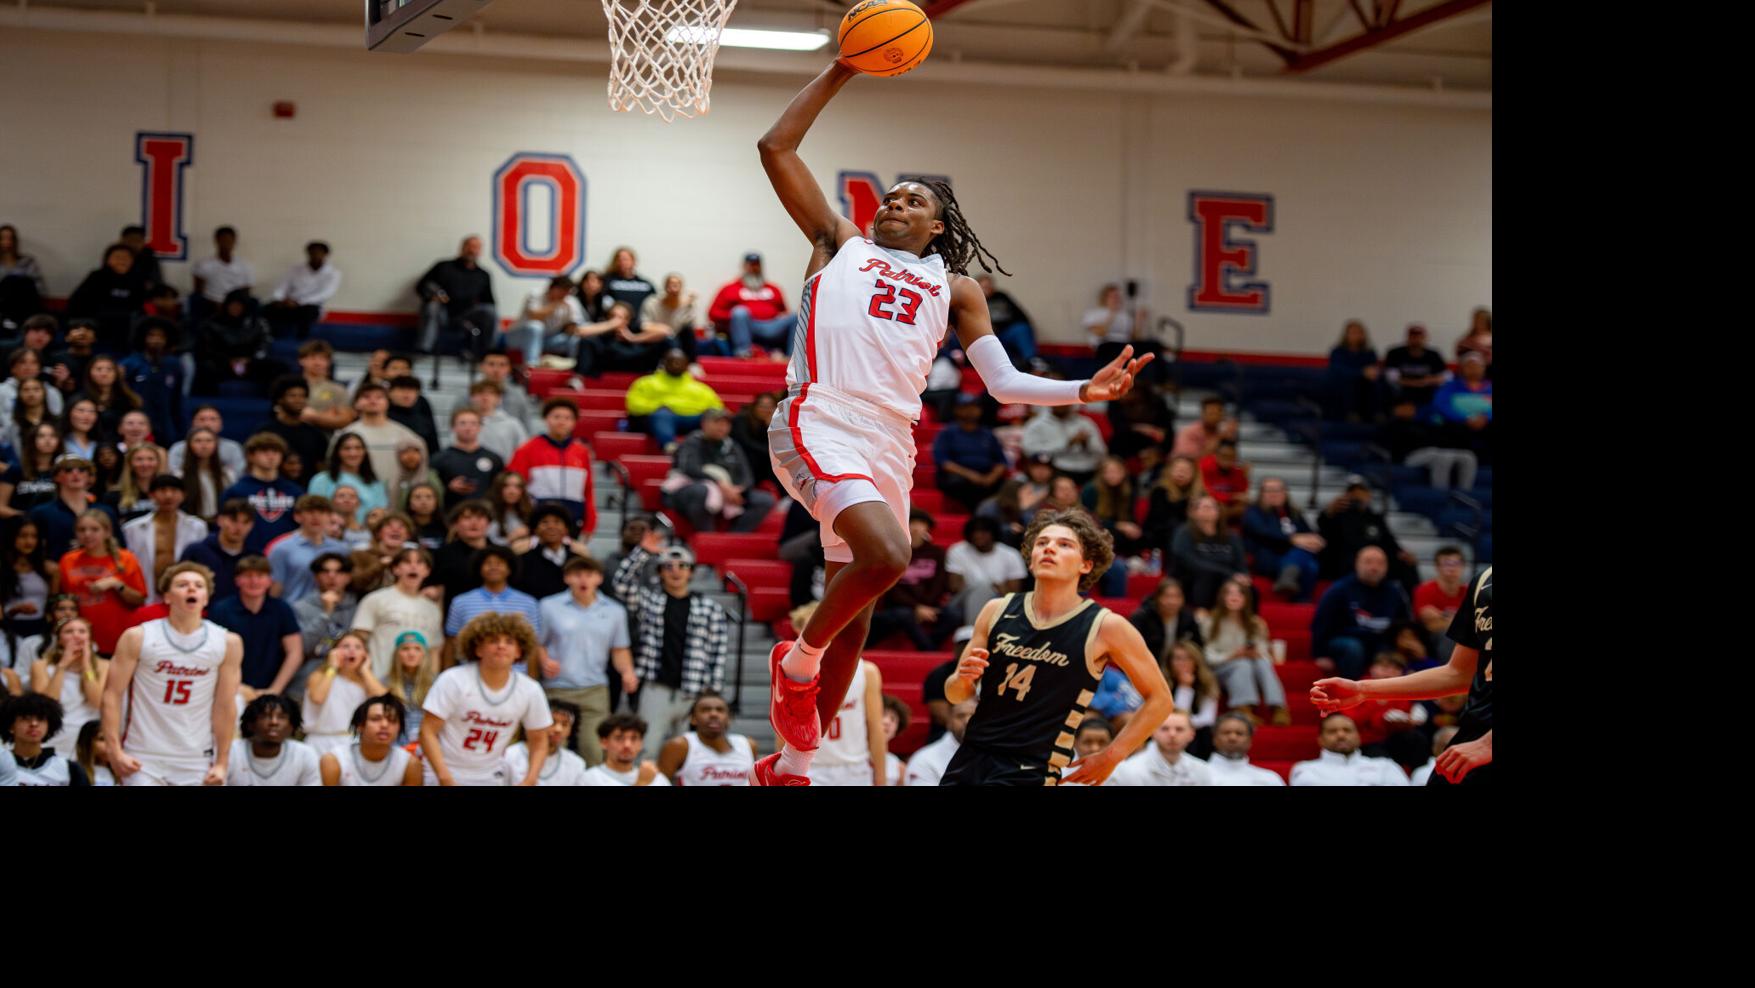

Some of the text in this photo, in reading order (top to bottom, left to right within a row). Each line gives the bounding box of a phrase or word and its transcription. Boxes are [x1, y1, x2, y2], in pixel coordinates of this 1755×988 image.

[1187, 190, 1275, 314] E
[859, 258, 942, 297] Patriot
[868, 279, 923, 325] 23
[992, 632, 1070, 667] Freedom
[163, 679, 194, 705] 15
[997, 662, 1037, 702] 14
[463, 728, 498, 753] 24
